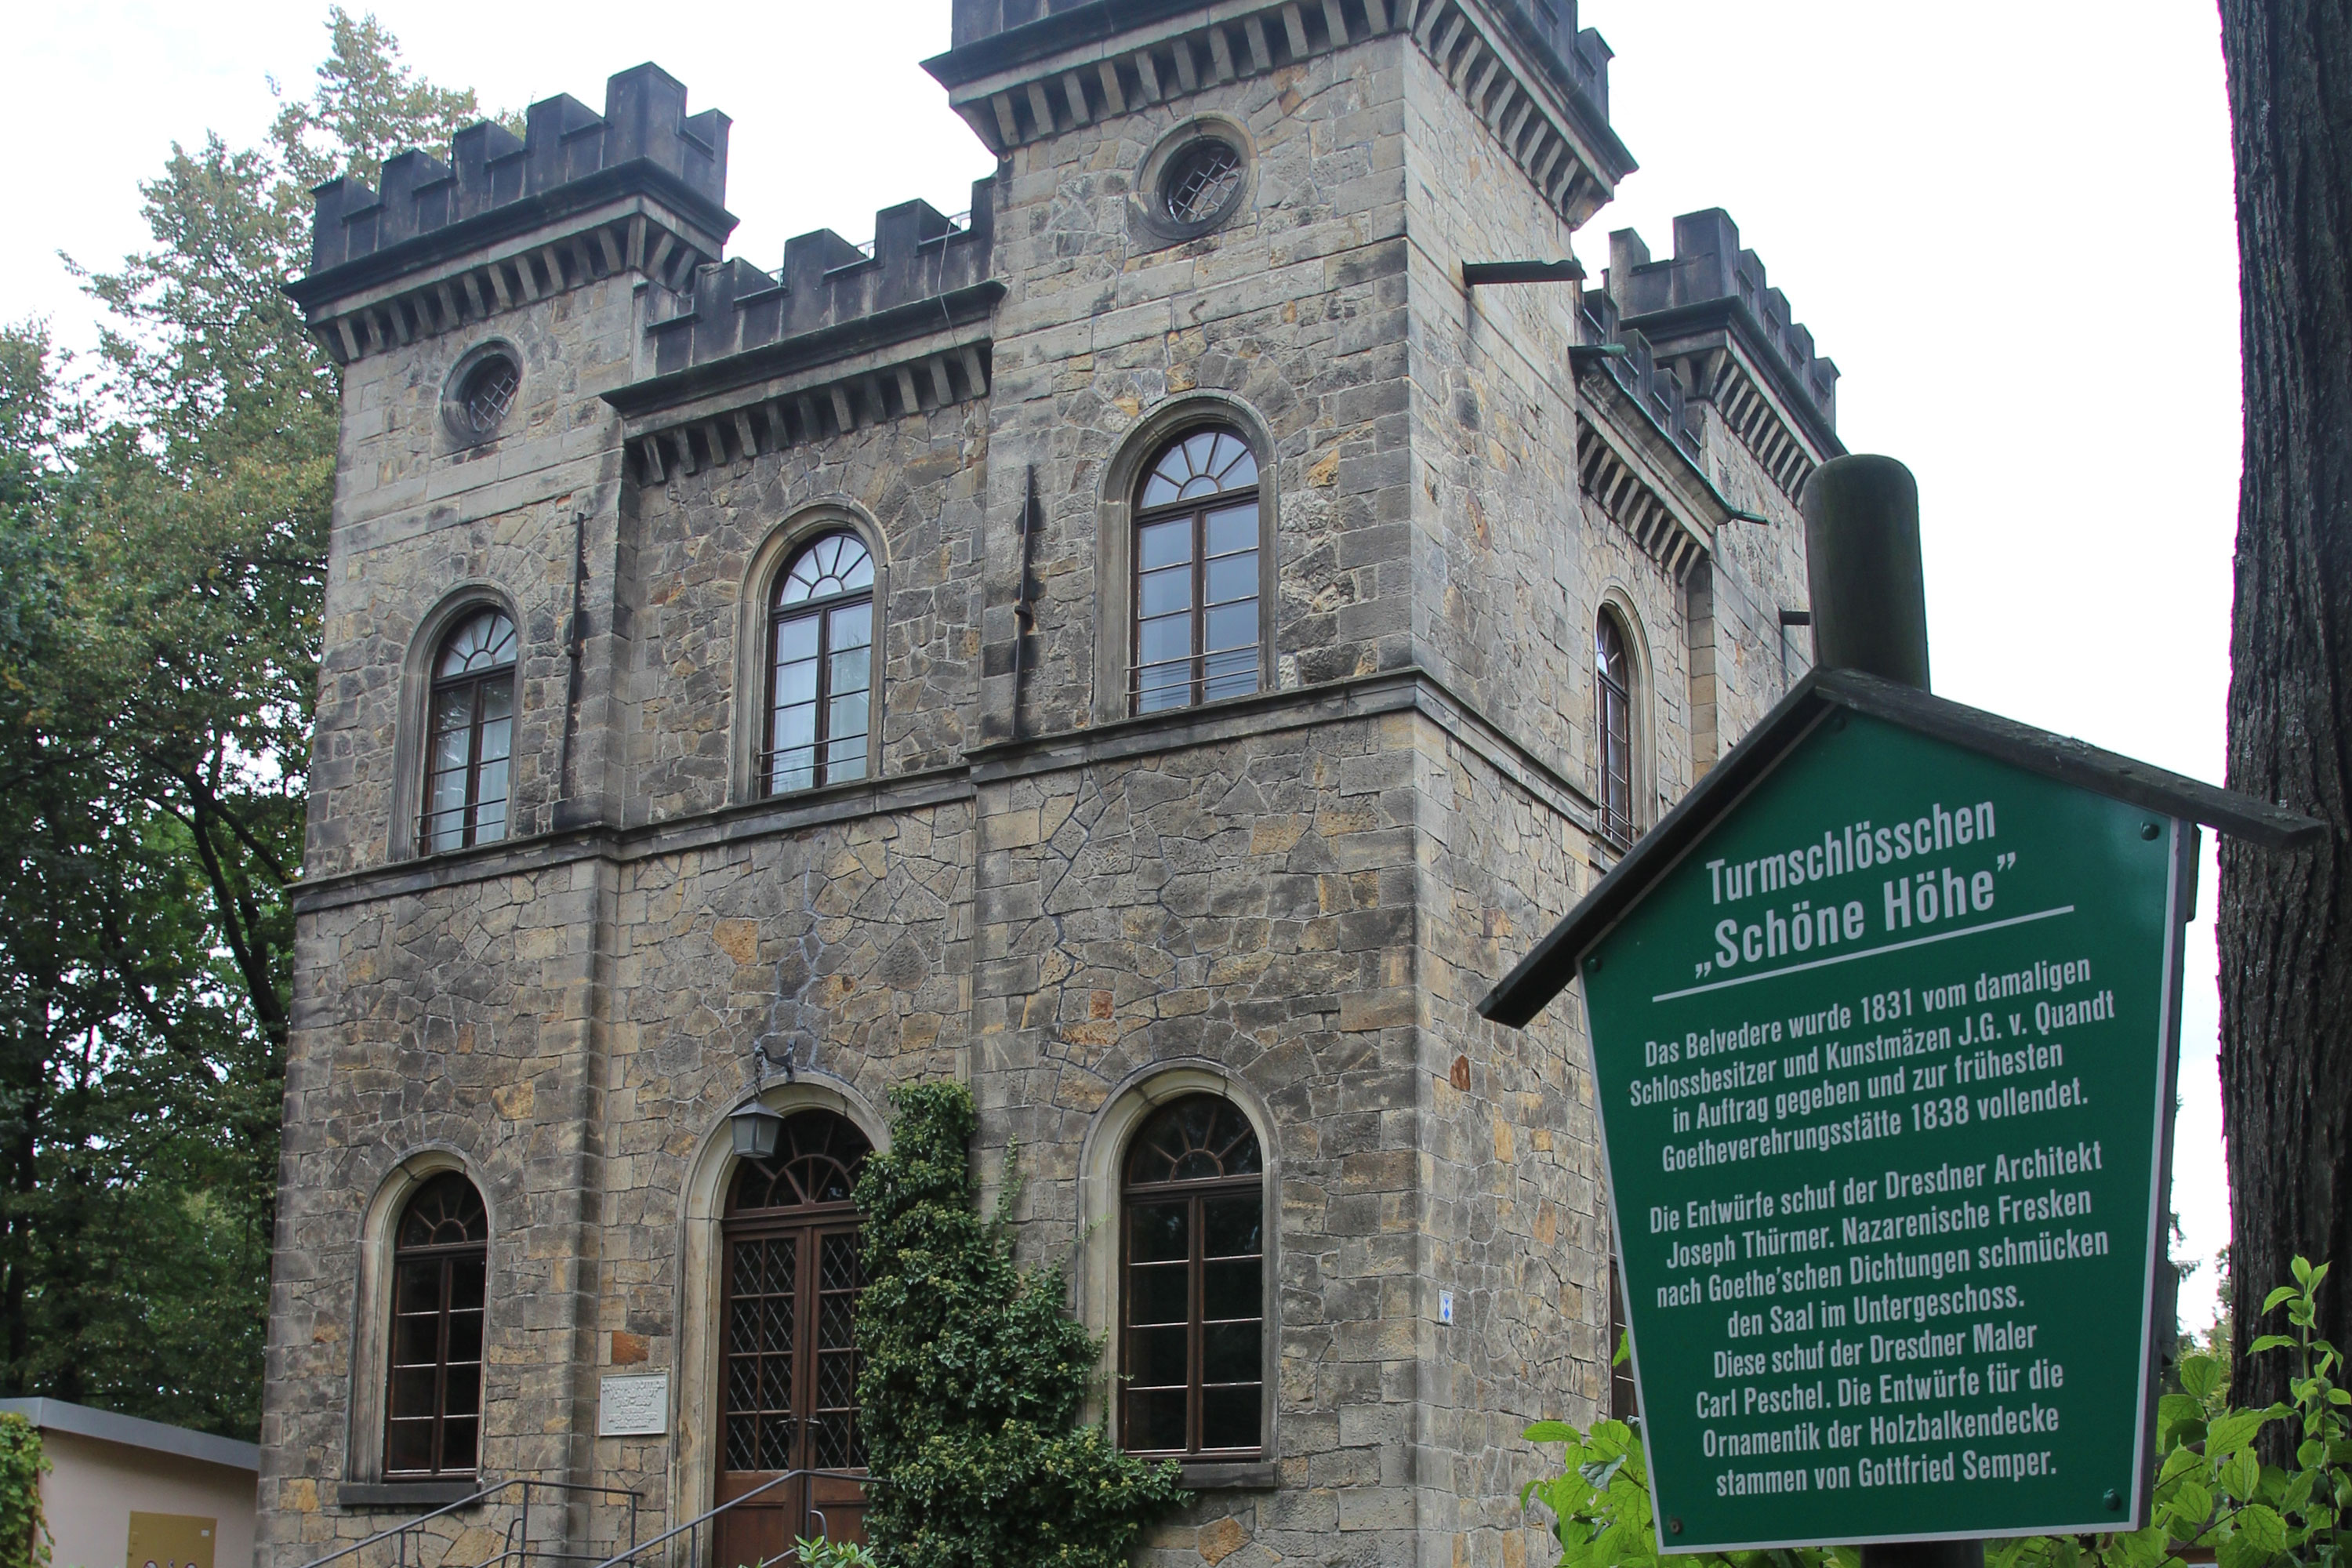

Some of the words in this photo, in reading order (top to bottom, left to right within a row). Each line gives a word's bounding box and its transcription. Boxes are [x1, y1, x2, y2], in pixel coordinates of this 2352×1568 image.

[1707, 802, 1994, 904] Turmschlösschen
[1631, 1060, 1777, 1106] Schlossbesitzer
[1784, 1047, 1818, 1078] und
[1827, 1028, 1951, 1070] Kunstmäzen
[1959, 1013, 2001, 1045] J.G.
[2009, 1014, 2027, 1035] v.
[2036, 991, 2114, 1035] Quandt
[1646, 1041, 1679, 1066] Das
[1687, 1022, 1781, 1058] Belvedere
[1789, 1004, 1850, 1038] wurde
[1862, 989, 1911, 1023] 1831
[1923, 984, 1966, 1011] vom
[1976, 960, 2090, 1001] damaligen
[1664, 1110, 1900, 1171] Goetheverehrungsstätte
[1912, 1096, 1969, 1131] 1838
[1978, 1077, 2088, 1120] vollendet.
[1674, 1108, 1689, 1133] in
[1697, 1098, 1768, 1129] Auftrag
[1777, 1080, 1859, 1119] gegeben
[1868, 1066, 1904, 1098] und
[1914, 1065, 1947, 1091] zur
[1955, 1044, 2062, 1083] frühesten
[1651, 1206, 1679, 1233] Die
[1688, 1192, 1773, 1228] Entwürfe
[1782, 1181, 1835, 1214] schuf
[1844, 1178, 1877, 1205] der
[1886, 1163, 1986, 1199] Dresdner
[1995, 1142, 2102, 1183] Architekt
[1658, 1278, 1700, 1307] nach
[1850, 1250, 1969, 1284] Dichtungen
[1979, 1229, 2107, 1269] schmücken
[1667, 1235, 1735, 1268] Joseph
[1743, 1227, 1834, 1258] Thürmer.
[1843, 1201, 1989, 1245] Nazarenische
[1999, 1189, 2091, 1224] Fresken
[1715, 1351, 1765, 1377] Diese
[1773, 1341, 1824, 1372] schuf
[1831, 1339, 1863, 1367] der
[1871, 1330, 1965, 1363] Dresdner
[1974, 1321, 2037, 1352] Maler
[1729, 1311, 1762, 1338] den
[1771, 1302, 1813, 1333] Saal
[1822, 1301, 1845, 1327] im
[1854, 1284, 2024, 1324] Untergeschoss.
[1697, 1389, 1736, 1418] Carl
[1745, 1381, 1830, 1414] Peschel.
[1838, 1377, 1871, 1406] Die
[1881, 1367, 1979, 1403] Entwürfe
[1987, 1363, 2020, 1392] für
[2030, 1359, 2063, 1389] die
[1704, 1423, 1820, 1457] Ornamentik
[1828, 1421, 1862, 1448] der
[1871, 1403, 2058, 1444] Holzbalkendecke
[1717, 1470, 1806, 1496] stammen
[1815, 1467, 1849, 1489] von
[1859, 1452, 1954, 1486] Gottfried
[1963, 1450, 2056, 1481] Semper.
